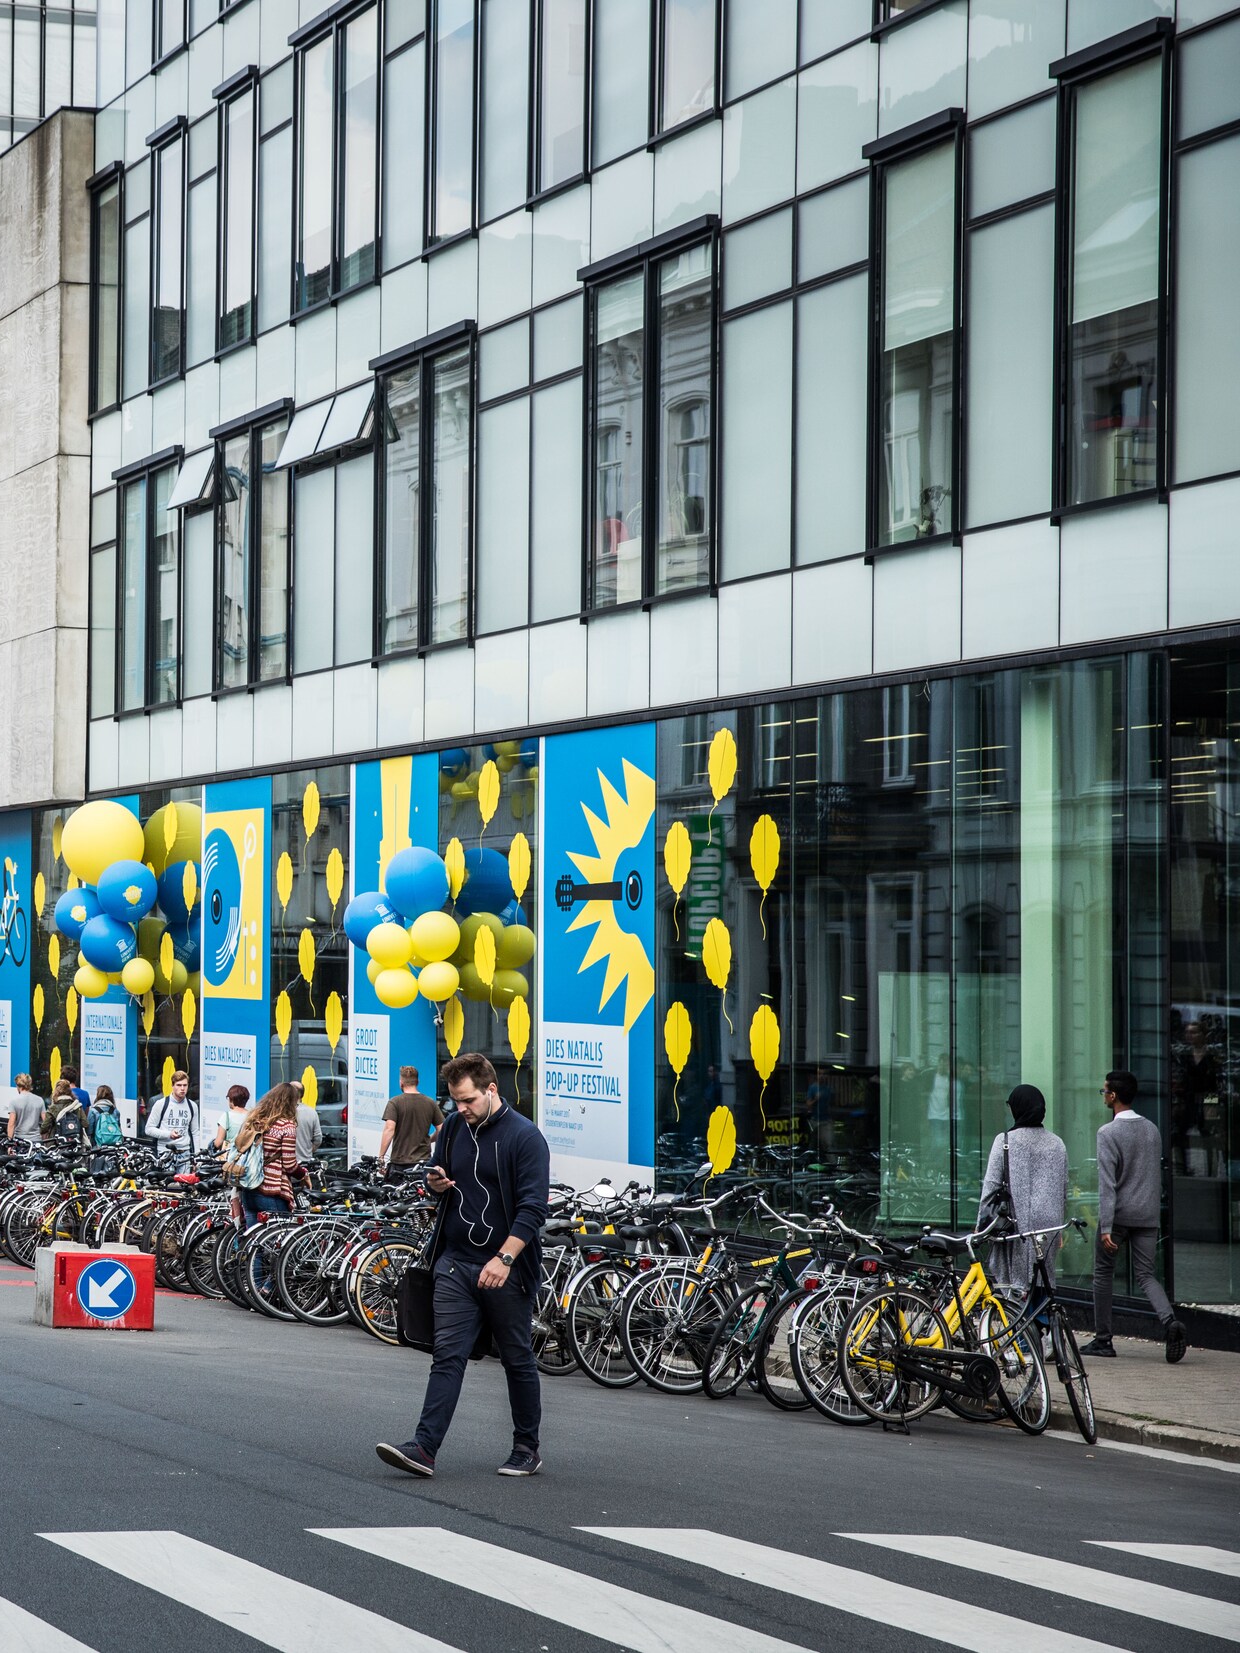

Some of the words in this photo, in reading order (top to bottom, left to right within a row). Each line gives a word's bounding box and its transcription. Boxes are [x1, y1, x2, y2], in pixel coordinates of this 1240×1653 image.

[86, 1014, 122, 1029] INTERNATIONALE
[356, 1028, 378, 1046] GROOT
[205, 1046, 216, 1061] DIES
[218, 1047, 251, 1064] NATALISFUIF
[546, 1039, 564, 1058] DIES
[568, 1040, 603, 1061] NATALIS
[356, 1057, 378, 1075] DICTEE
[546, 1071, 578, 1092] POP-UP
[582, 1075, 621, 1097] FESTIVAL
